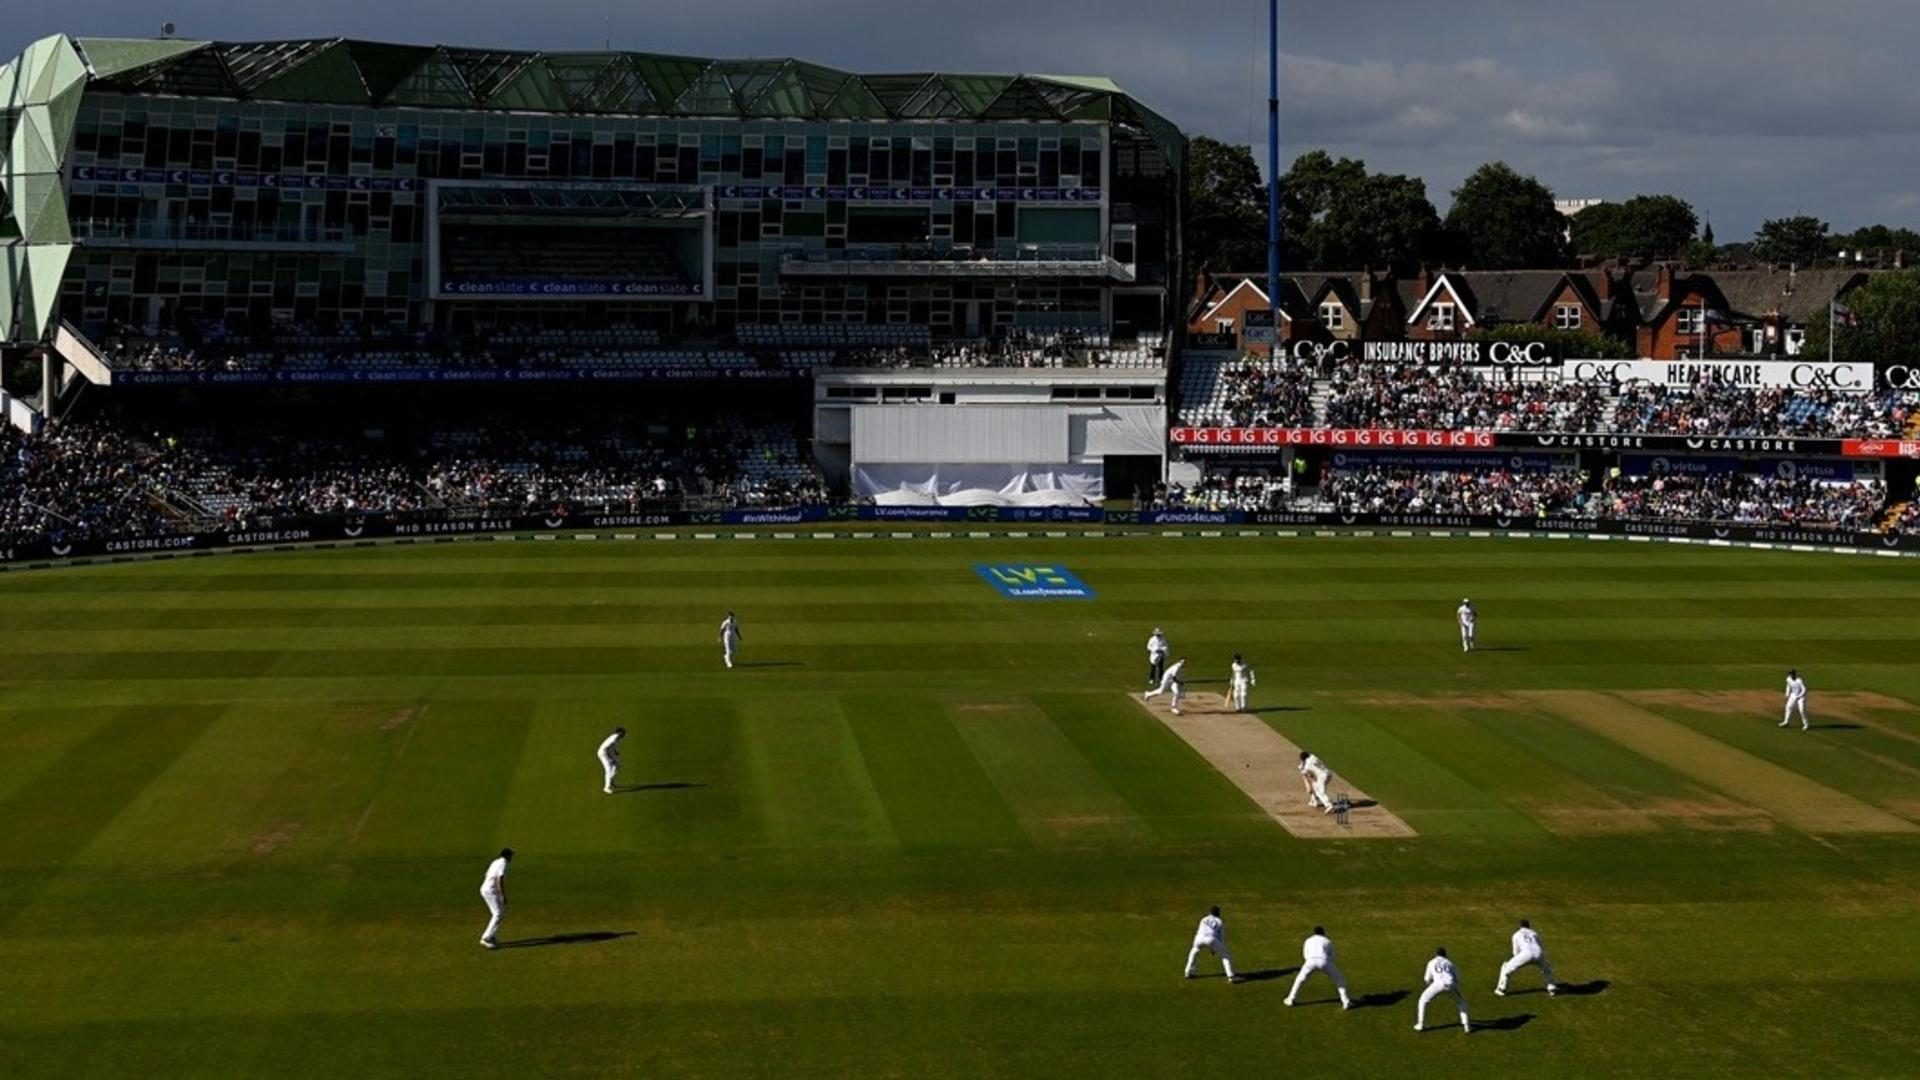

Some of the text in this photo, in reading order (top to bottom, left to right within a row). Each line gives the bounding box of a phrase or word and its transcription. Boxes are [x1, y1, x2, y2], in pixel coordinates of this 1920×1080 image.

[1364, 342, 1426, 362] INSURANCE
[1430, 342, 1479, 362] BROKERS
[1171, 429, 1490, 446] IG IG IG IG IG IG IG IG IG IG IG IG IG IG
[1561, 436, 1643, 447] CASTORE
[1710, 440, 1795, 451] CASTORE
[593, 515, 670, 527] CASTORE.COM
[1256, 514, 1318, 524] CASTORE.COM
[1380, 515, 1471, 526] MID SEASON SALE
[1535, 519, 1598, 530] CASTORE.COM
[395, 519, 512, 534] MID SEASON SALE
[1625, 523, 1688, 535] CASTORE.COM
[228, 530, 310, 543] CASTORE.COM
[1755, 530, 1855, 545] MID SEASON SALE
